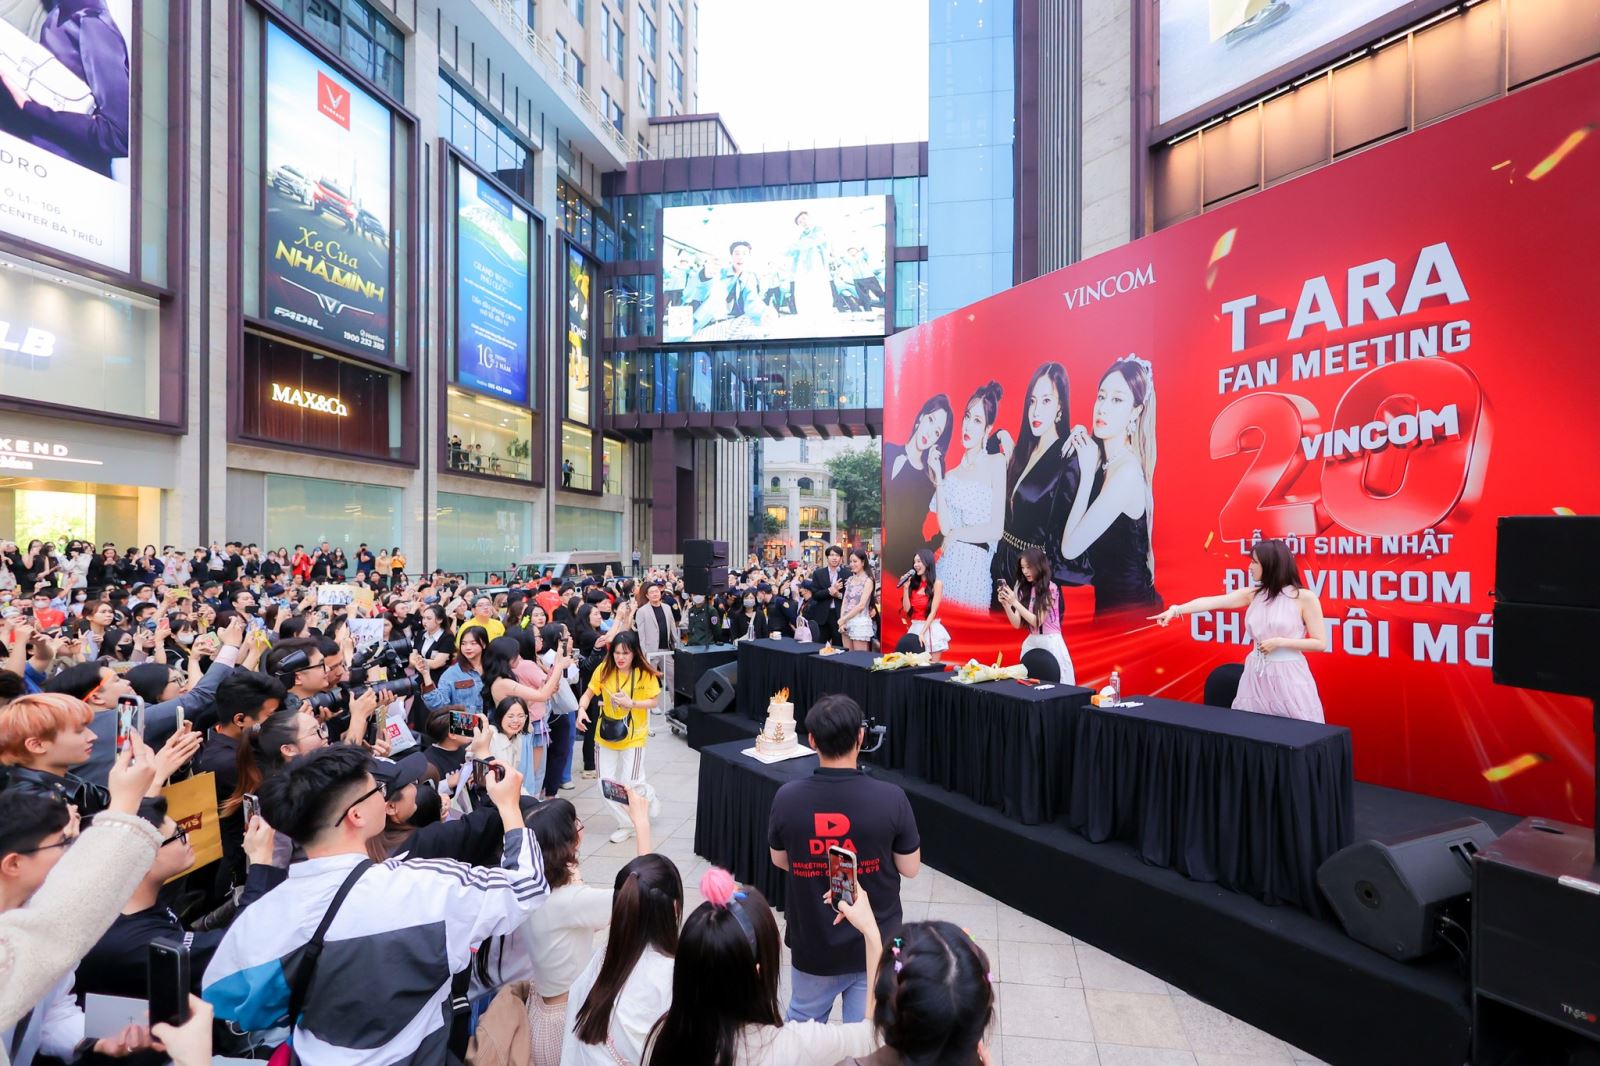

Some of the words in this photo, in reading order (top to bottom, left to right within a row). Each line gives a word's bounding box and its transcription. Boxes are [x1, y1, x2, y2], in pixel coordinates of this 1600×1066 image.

[0, 203, 48, 226] CENTER
[275, 239, 330, 283] NHÀ
[294, 227, 324, 252] Xe
[1063, 262, 1156, 311] VINCOM
[1222, 242, 1470, 352] T-ARA
[274, 306, 324, 330] FADIL
[1219, 358, 1278, 394] FAN
[1292, 320, 1470, 381] MEETING
[1210, 357, 1493, 541] 20
[1301, 404, 1460, 461] VINCOM
[1314, 536, 1371, 555] SINH
[1382, 529, 1453, 559] NHẬT
[1303, 569, 1471, 604] VINCOM
